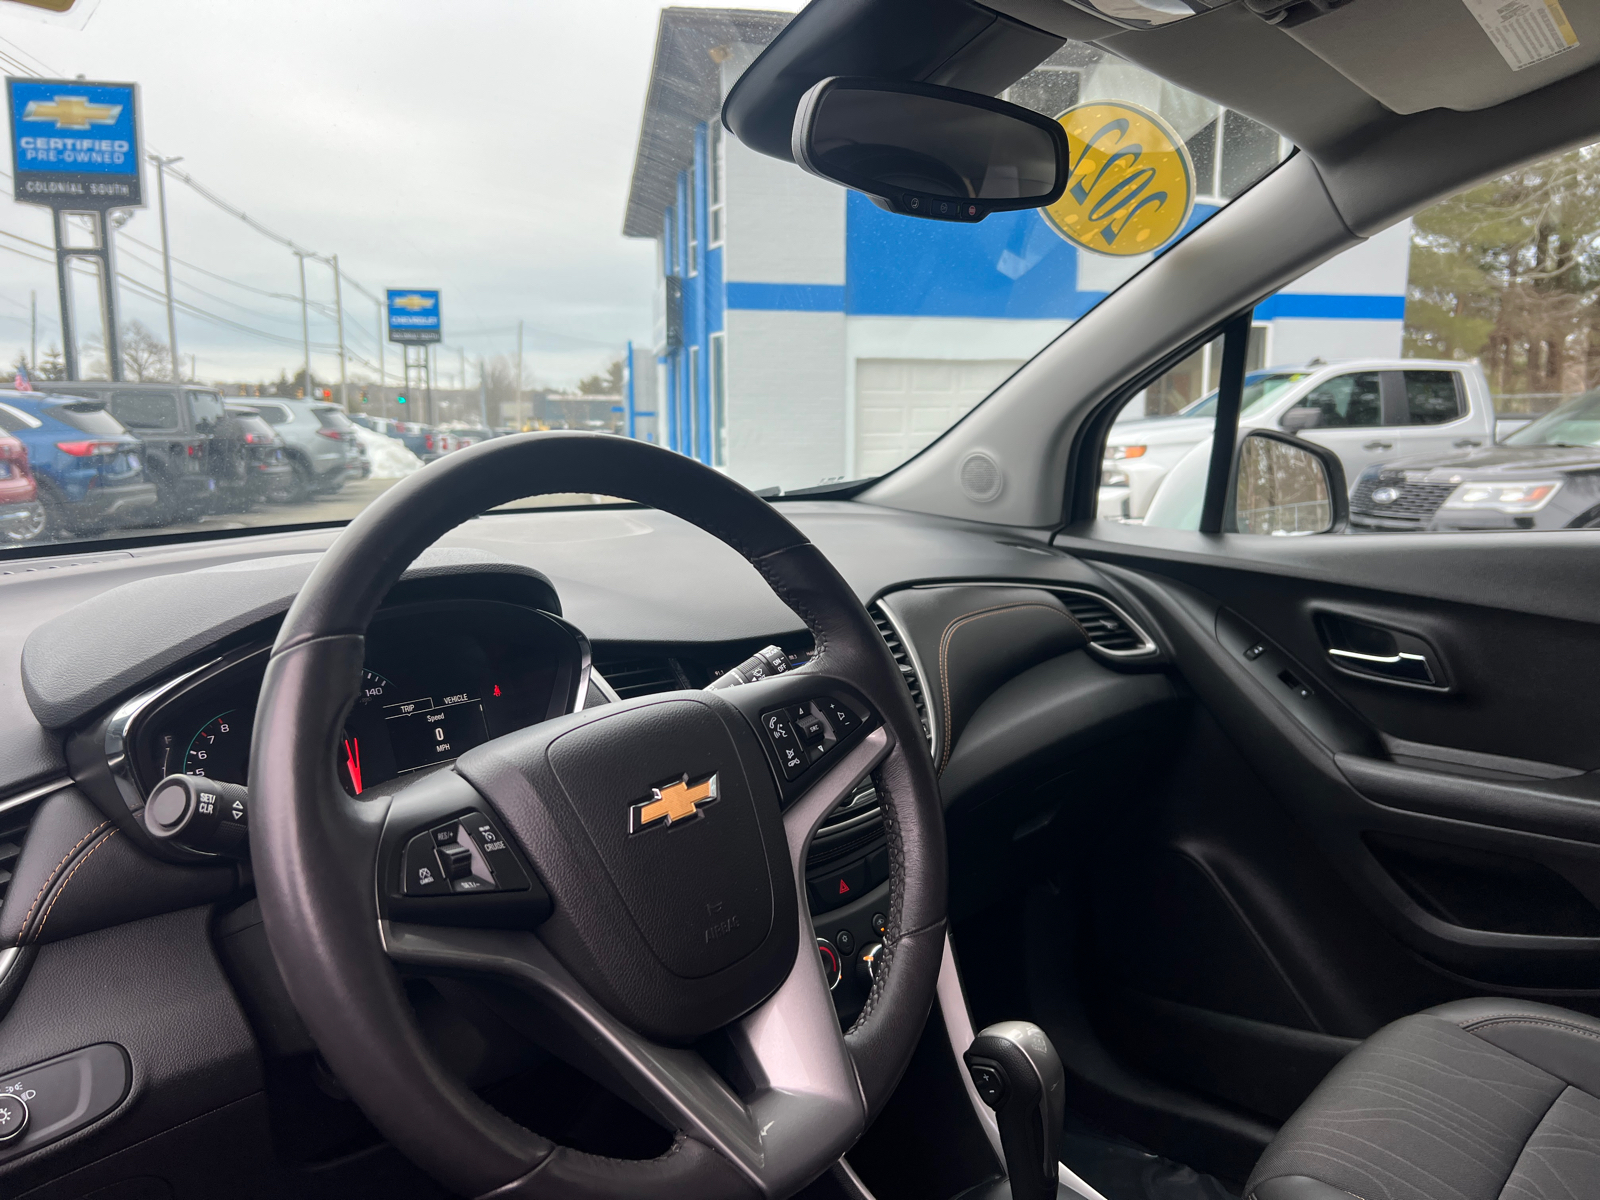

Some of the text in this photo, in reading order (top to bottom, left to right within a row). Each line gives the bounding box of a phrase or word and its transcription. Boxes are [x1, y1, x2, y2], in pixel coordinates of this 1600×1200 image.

[20, 137, 129, 152] CERTIFIED
[26, 150, 124, 164] PRE-OWNED
[25, 181, 129, 196] COLONIAL SOUTH
[777, 664, 788, 673] OFF
[365, 687, 383, 697] 140
[443, 693, 468, 704] VEHICLE
[400, 704, 415, 713] TRIP
[427, 712, 445, 723] Speed
[220, 724, 230, 732] 8
[207, 735, 215, 744] 7
[435, 727, 445, 741] 0
[436, 743, 451, 753] MPH
[198, 750, 208, 760] 6
[195, 768, 205, 777] 5
[200, 792, 216, 803] SET/
[199, 802, 214, 814] CLR
[484, 840, 506, 852] CRUISE
